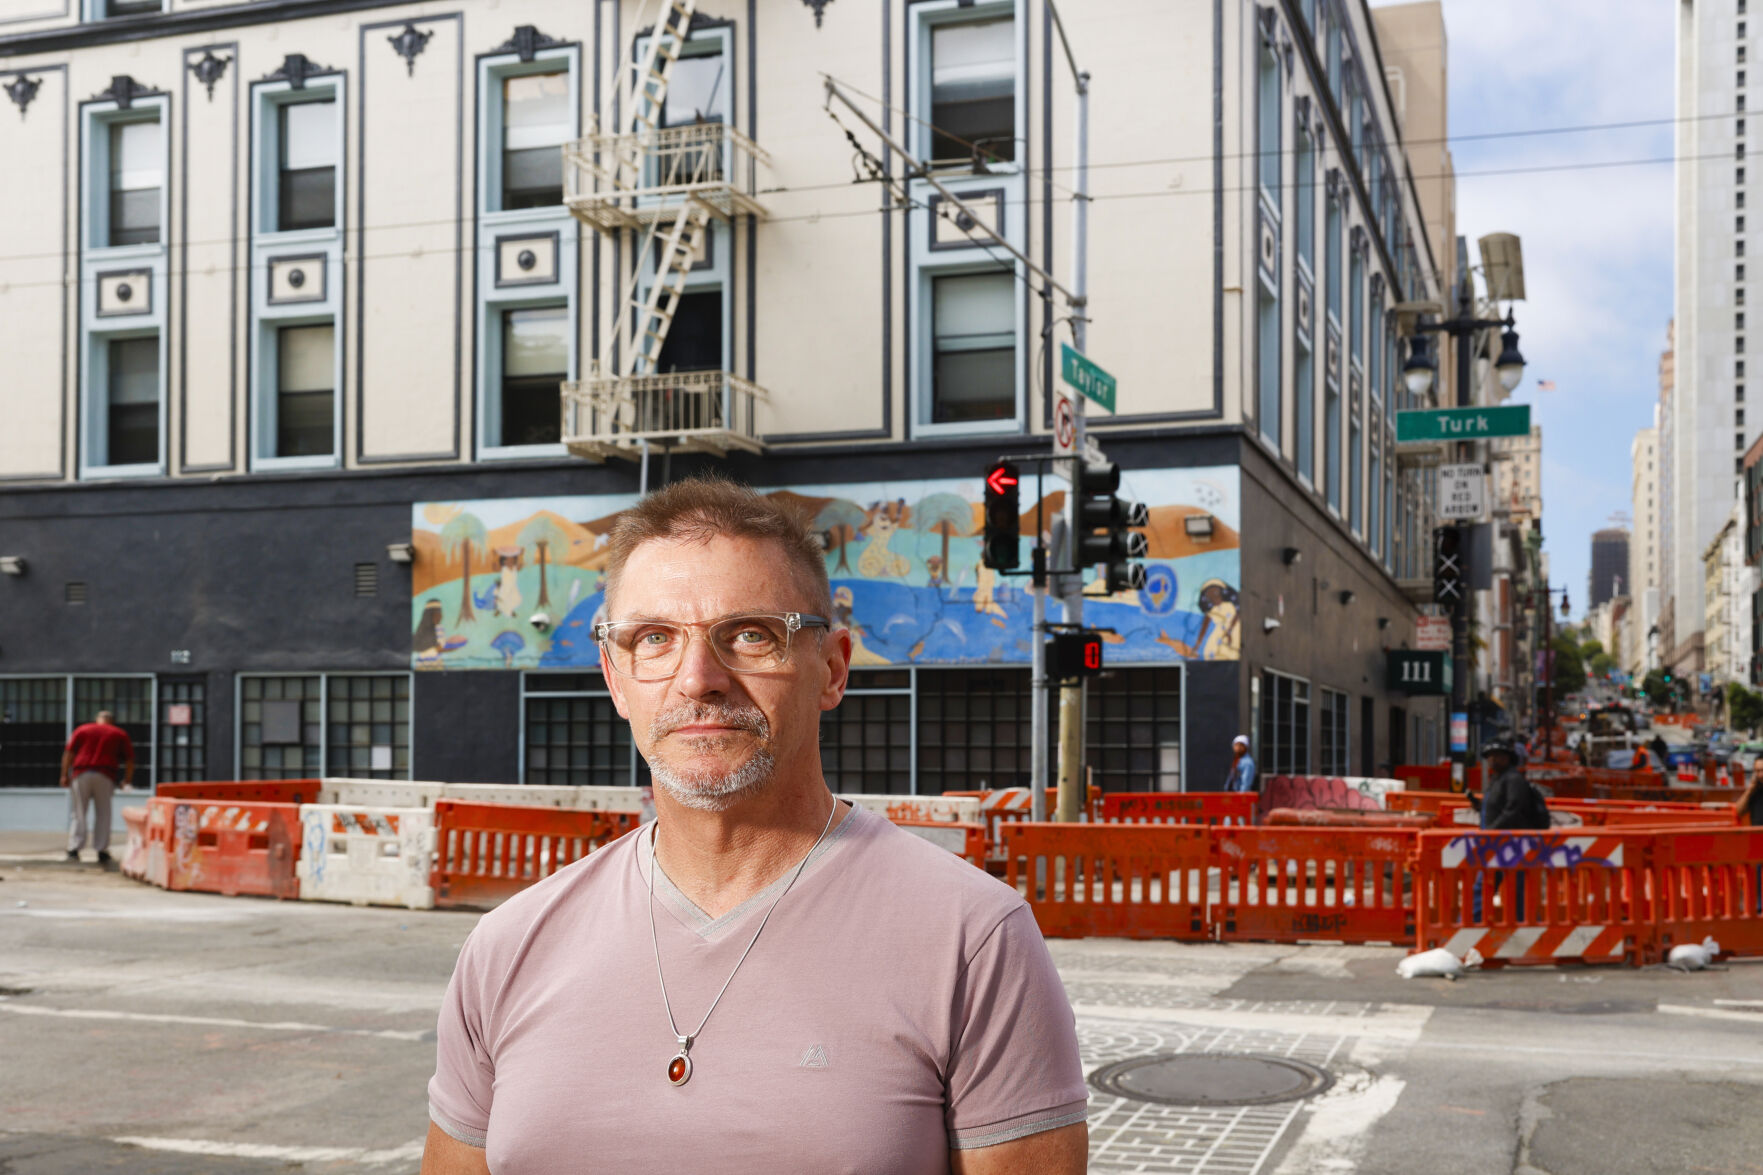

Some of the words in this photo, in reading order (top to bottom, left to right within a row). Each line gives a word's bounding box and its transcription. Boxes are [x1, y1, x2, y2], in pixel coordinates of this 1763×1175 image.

[1071, 358, 1108, 400] Taylor
[1437, 415, 1489, 432] Turk
[1441, 469, 1455, 478] NO
[1457, 467, 1481, 477] TURN
[1454, 480, 1468, 490] ON
[1451, 491, 1471, 502] RED
[1445, 503, 1479, 514] ARROW
[1400, 660, 1432, 682] 111
